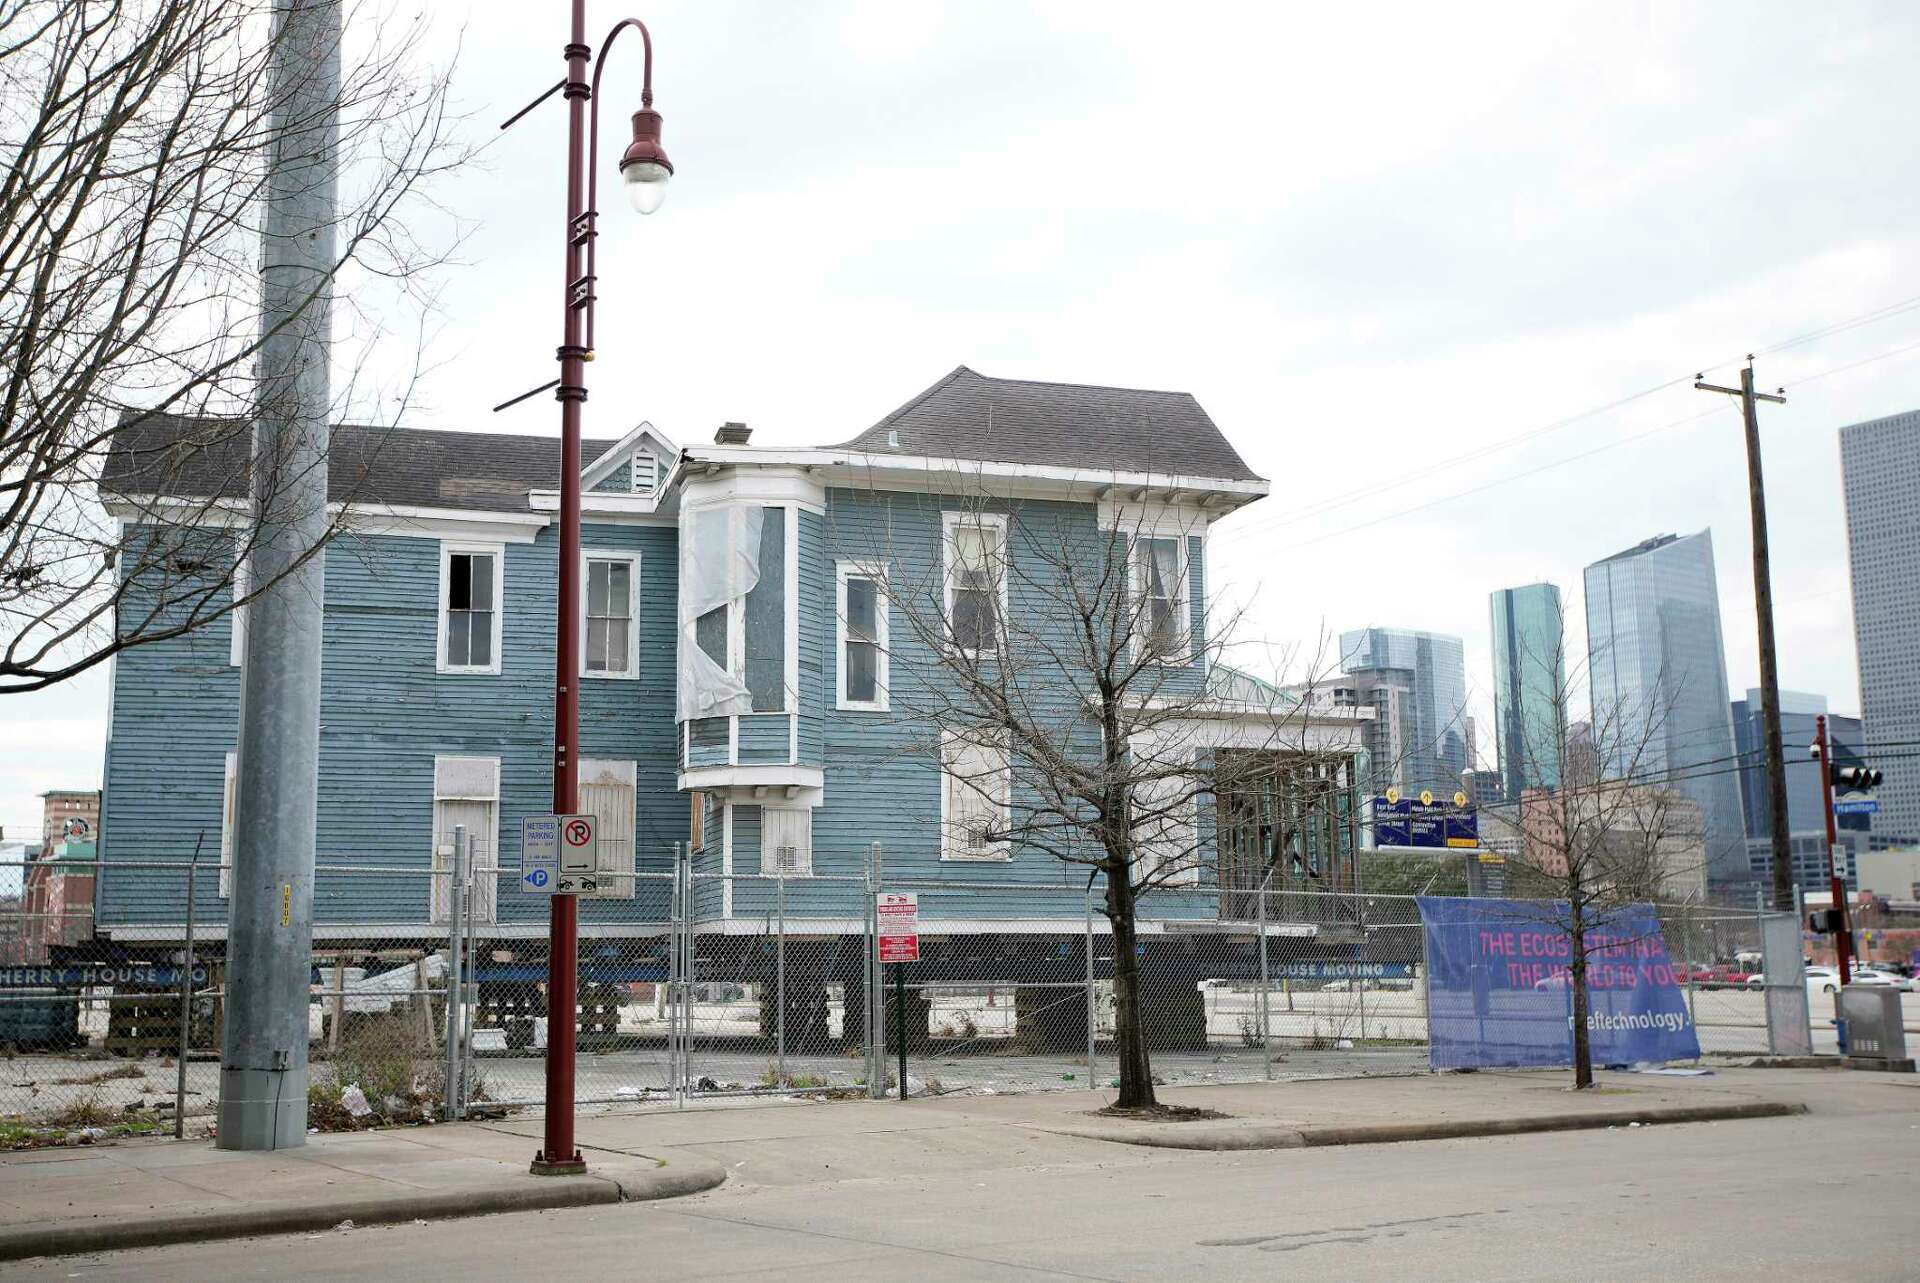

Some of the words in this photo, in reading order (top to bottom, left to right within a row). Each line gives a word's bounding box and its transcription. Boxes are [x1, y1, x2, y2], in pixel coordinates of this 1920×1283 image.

[1836, 802, 1876, 814] Hamilton
[527, 822, 556, 830] METERED
[527, 831, 555, 840] PARKING
[1480, 933, 1516, 958] THE
[1520, 934, 1626, 959] ECOSSTEM
[1628, 934, 1665, 959] THA
[82, 968, 157, 983] HOUSE
[1322, 963, 1384, 976] MOVING
[1508, 963, 1543, 990] THE
[1568, 1010, 1689, 1032] reftechnology.
